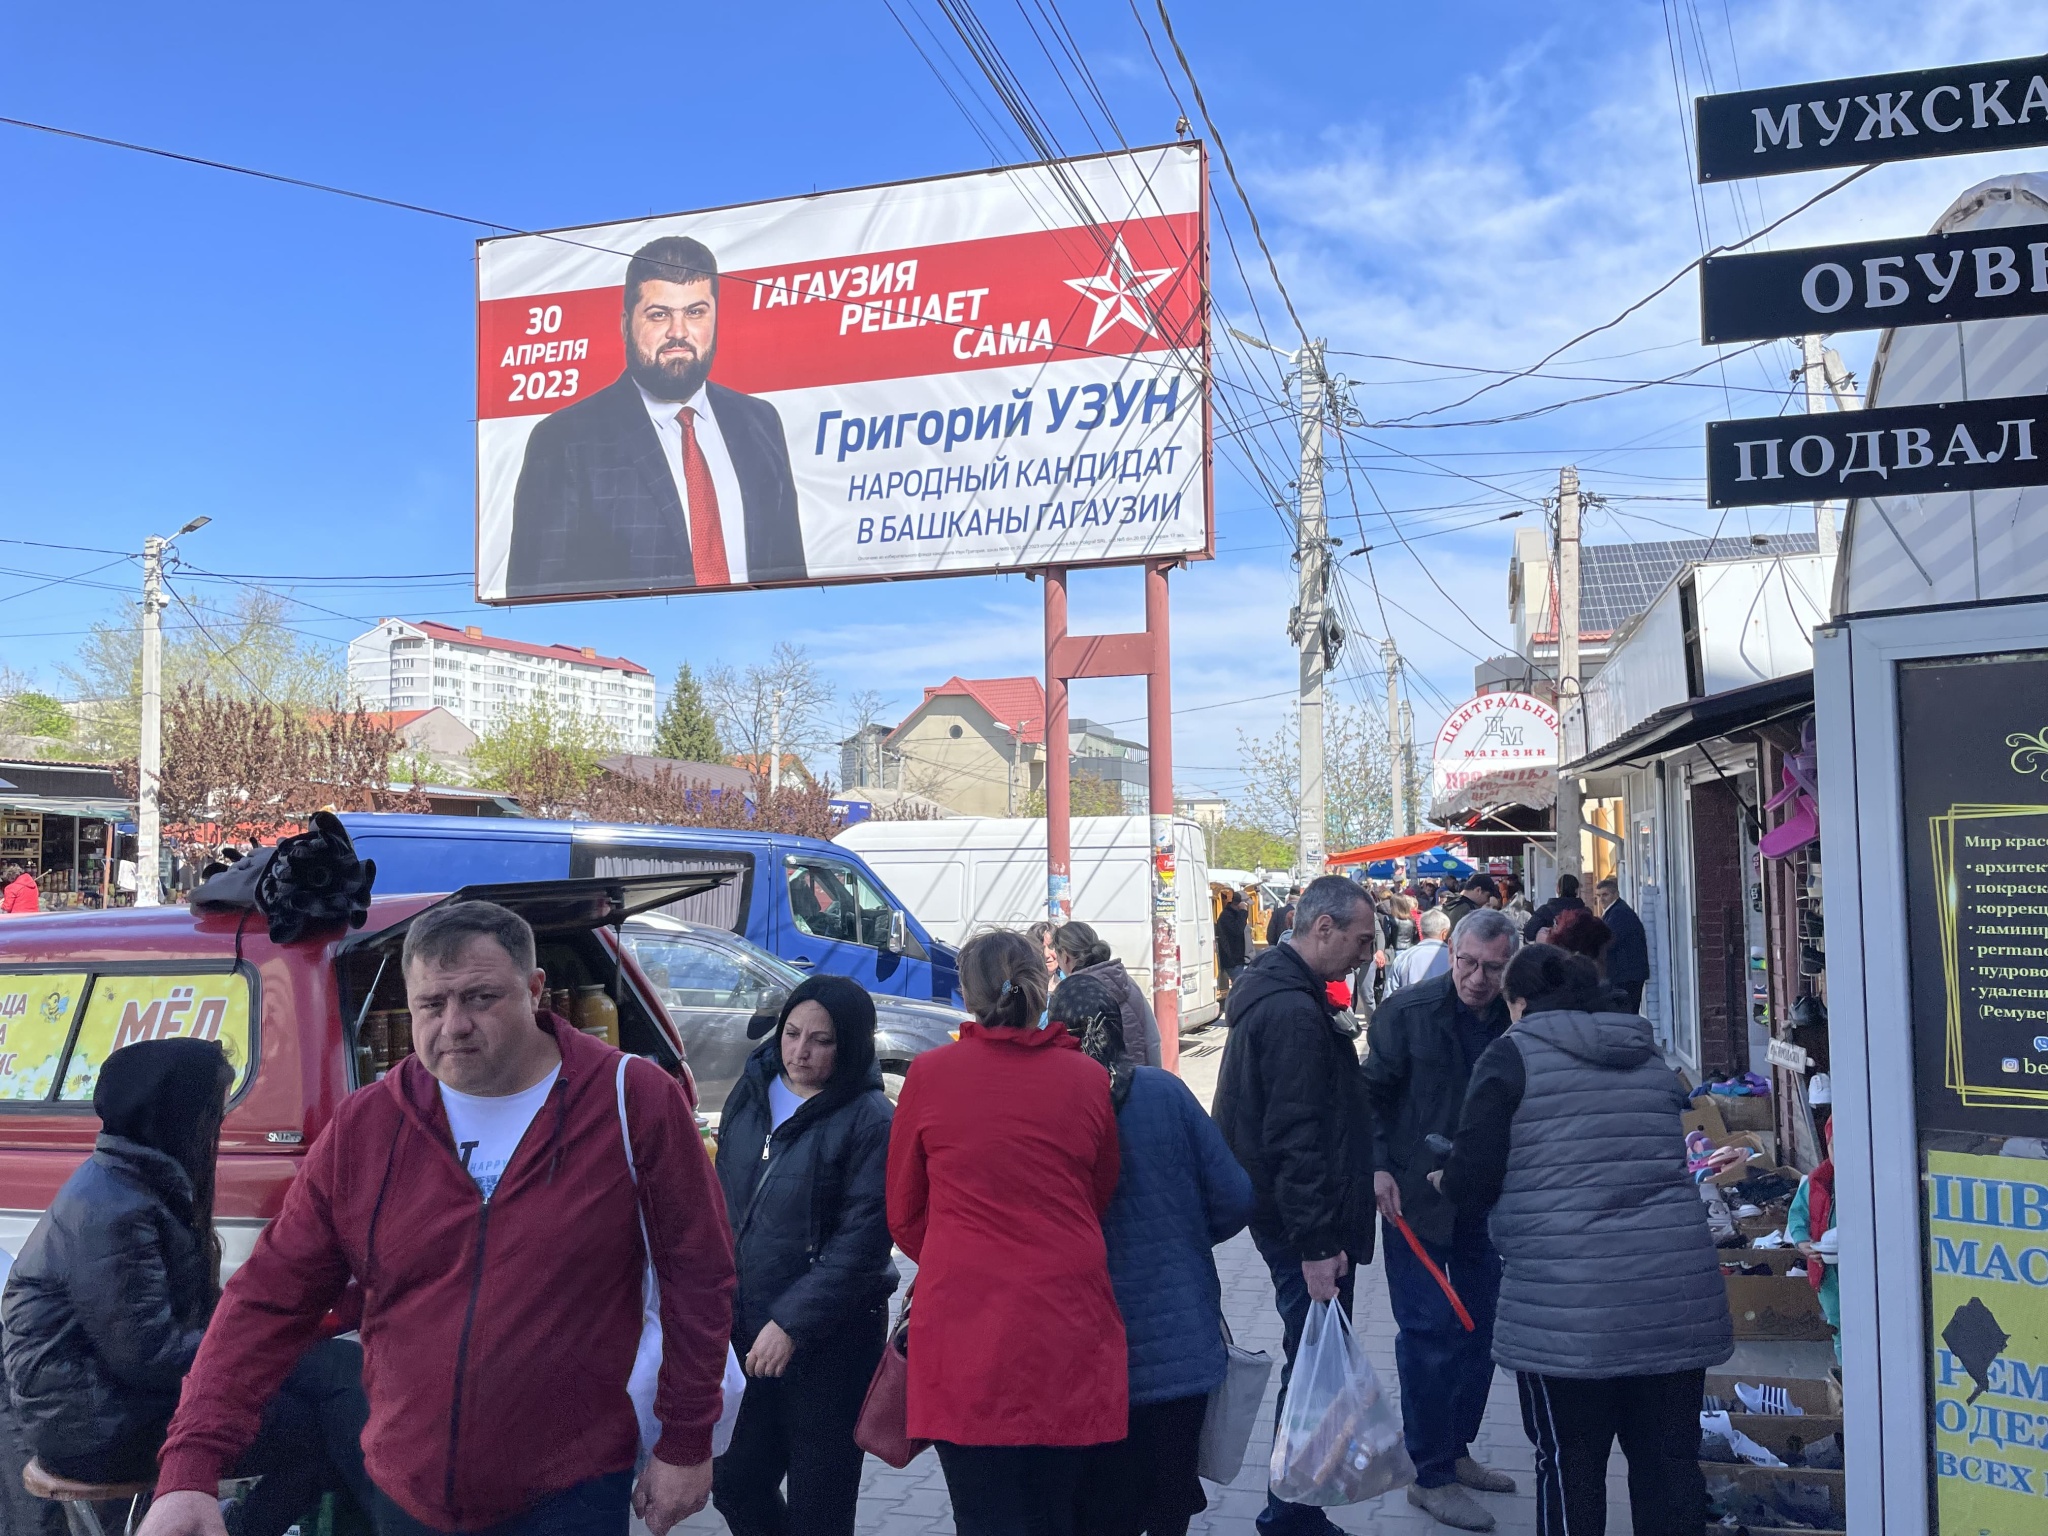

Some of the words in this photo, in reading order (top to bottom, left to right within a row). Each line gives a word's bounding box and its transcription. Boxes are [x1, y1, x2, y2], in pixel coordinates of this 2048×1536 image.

[1751, 74, 2048, 153] МУЖСКА
[752, 259, 918, 310] ГАГАУЗИЯ
[525, 305, 563, 335] 30
[840, 288, 989, 335] РЕШАЕТ
[500, 338, 589, 368] АПРЕЛЯ
[952, 318, 1054, 360] САМА
[507, 368, 579, 402] 2023
[814, 388, 1033, 463] Григорий
[1046, 376, 1181, 434] УЗУН
[1733, 418, 2037, 484] ПОДВАЛ
[847, 455, 1010, 502] НАРОДНЫЙ
[1015, 446, 1182, 488] КАНДИДАТ
[856, 516, 875, 544] В
[879, 503, 1030, 543] БАШКАНЫ
[1036, 492, 1182, 532] ГАГАУЗИИ
[1443, 697, 1559, 744] ЦЕНТРАЛЬНЫ
[1964, 835, 2002, 850] Мир
[2005, 837, 2048, 850] крас
[1975, 863, 2048, 876] архитек
[1975, 884, 2048, 897] покраск
[1978, 965, 2048, 979] пудрово
[1978, 986, 2048, 999] удалени
[112, 988, 228, 1051] МЁЛ
[1978, 1004, 2048, 1022] (Ремуве
[1931, 1174, 2048, 1231] ШВ
[1937, 1451, 2035, 1494] ВСЕХ
